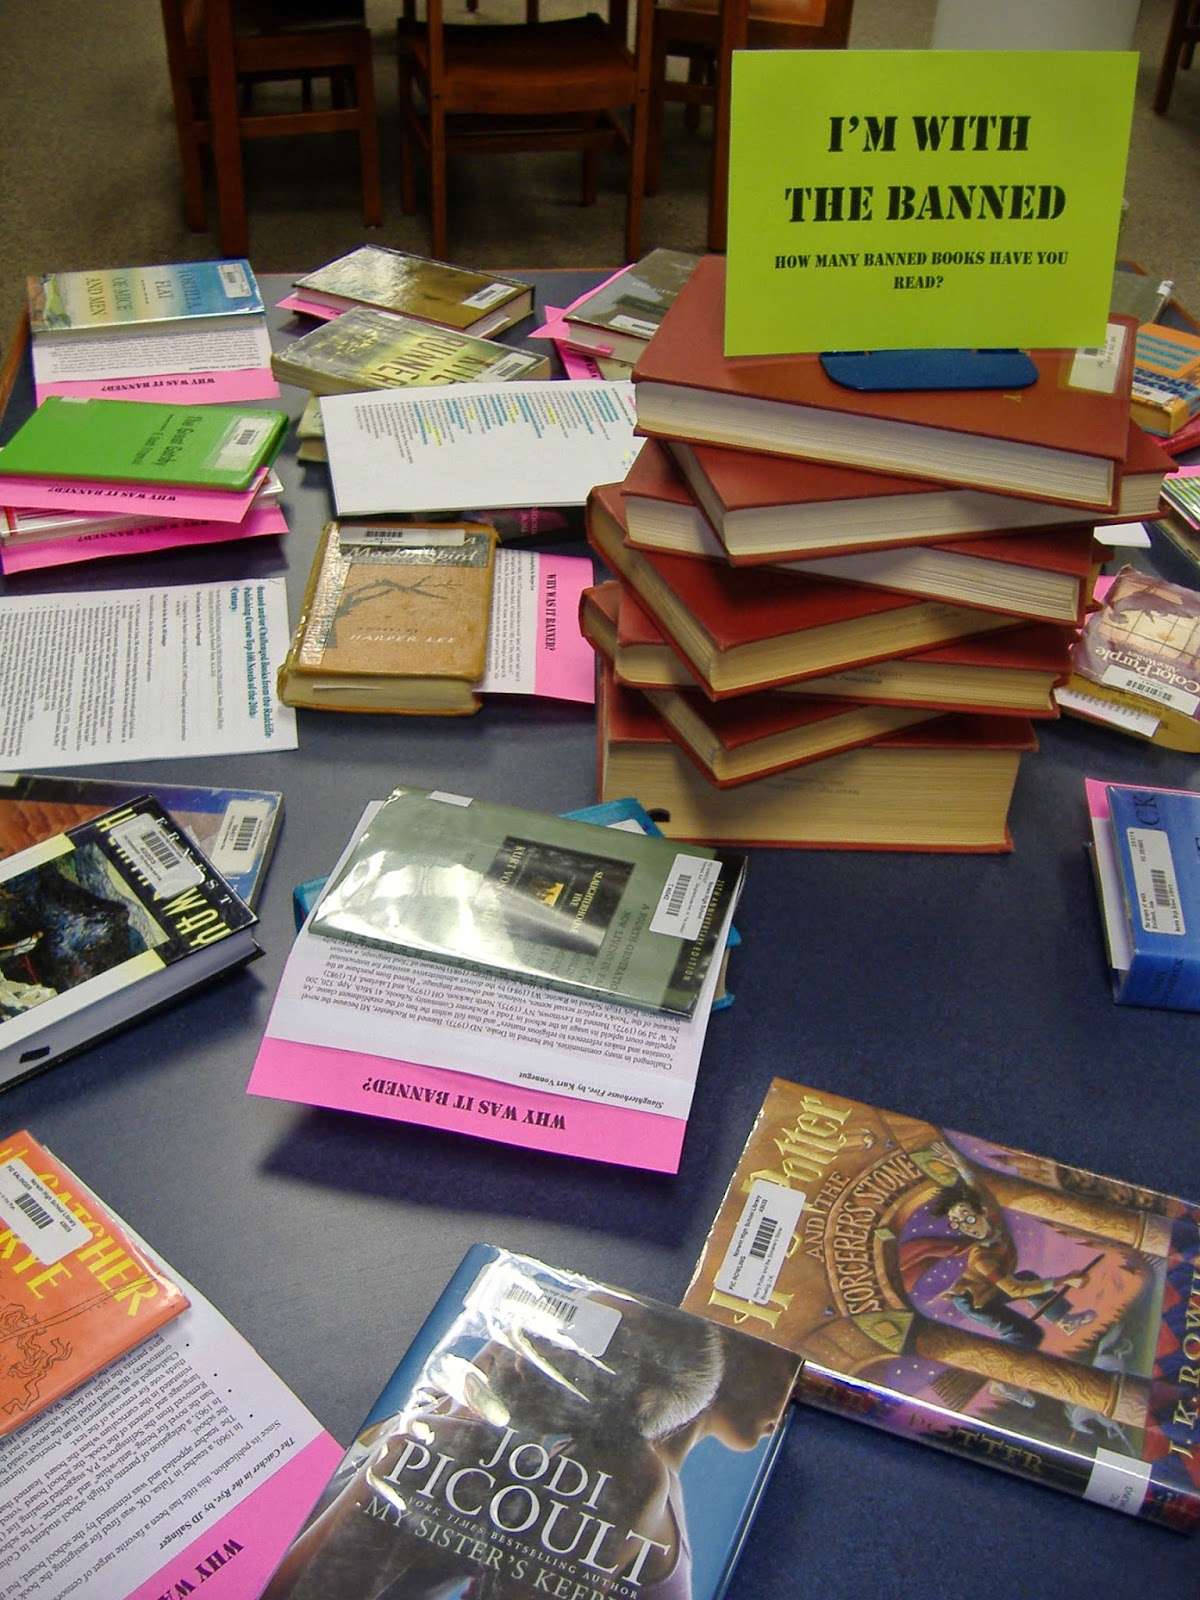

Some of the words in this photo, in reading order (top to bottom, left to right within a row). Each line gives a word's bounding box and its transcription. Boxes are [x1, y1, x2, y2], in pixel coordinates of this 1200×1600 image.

[827, 115, 898, 152] I'M
[911, 115, 1032, 151] WITH
[785, 186, 874, 223] THE
[886, 184, 1067, 221] BANNED
[774, 254, 811, 270] HOW
[815, 253, 860, 268] MANY
[863, 252, 928, 267] BANNED
[931, 251, 985, 266] BOOKS
[989, 251, 1033, 266] HAVE
[1037, 250, 1070, 266] YOU
[154, 278, 174, 301] FLAT
[893, 274, 945, 290] READ?
[88, 294, 107, 317] MEN
[113, 288, 134, 312] MICE
[369, 333, 469, 389] RUNNER
[100, 381, 149, 391] BANNED?
[545, 573, 556, 590] WHY
[545, 591, 556, 607] WAS
[545, 608, 556, 616] IT
[243, 616, 255, 638] Course
[544, 617, 556, 650] BANNED?
[242, 638, 255, 650] Top
[256, 627, 269, 661] Challenged
[259, 661, 270, 679] Books
[1094, 646, 1153, 676] Purple
[261, 679, 271, 695] from
[1151, 667, 1200, 693] Color
[247, 689, 257, 699] the
[262, 696, 272, 706] the
[505, 842, 527, 870] KURT
[567, 869, 605, 935] SLAUGHTERHOUSE
[681, 946, 701, 981] EDITION
[300, 992, 320, 1002] novel
[319, 995, 332, 1004] the
[331, 998, 359, 1009] because
[407, 1012, 416, 1021] in
[416, 1014, 443, 1025] Banned
[468, 1023, 483, 1032] ND
[483, 1026, 508, 1038] Drake,
[507, 1031, 516, 1040] in
[516, 1033, 542, 1045] burned
[541, 1039, 554, 1048] but
[554, 1041, 603, 1056] communities,
[602, 1048, 623, 1059] many
[623, 1054, 632, 1062] in
[631, 1055, 673, 1071] Challenged
[518, 1070, 555, 1086] Vonnegut
[555, 1080, 575, 1090] Kurt
[360, 1075, 450, 1106] BANNED?
[576, 1082, 587, 1093] by
[586, 1086, 606, 1097] Five,
[452, 1093, 474, 1111] IT
[606, 1089, 664, 1109] Slaughterhouse
[476, 1098, 519, 1121] WAS
[521, 1107, 567, 1130] WHY
[853, 1153, 924, 1205] STONE
[813, 1170, 851, 1211] THE
[739, 1227, 749, 1239] High
[744, 1210, 755, 1227] School
[750, 1194, 762, 1212] Library
[804, 1217, 826, 1263] AND
[731, 1254, 746, 1280] ROWLING
[259, 1419, 282, 1439] Since
[249, 1434, 263, 1447] its
[278, 1436, 296, 1452] The
[208, 1440, 254, 1479] publication,
[250, 1447, 282, 1475] Catcher
[478, 1425, 613, 1510] JODI
[195, 1474, 213, 1491] this
[229, 1477, 245, 1492] the
[242, 1470, 254, 1482] in
[180, 1485, 199, 1502] title
[211, 1486, 233, 1506] Rye,
[167, 1497, 184, 1513] has
[201, 1499, 216, 1514] by
[383, 1438, 672, 1587] PICOULT
[149, 1508, 171, 1527] been
[189, 1509, 206, 1525] JD
[143, 1522, 151, 1531] a
[156, 1519, 193, 1551] Salinger
[113, 1527, 146, 1556] favorite
[364, 1495, 411, 1529] MY
[413, 1517, 532, 1580] SISTER'S
[90, 1549, 116, 1572] target
[189, 1534, 246, 1583] WHY
[446, 1513, 484, 1535] TIMES
[490, 1532, 578, 1575] BESTSELLING
[582, 1570, 640, 1600] AUTHOR
[81, 1568, 95, 1582] of
